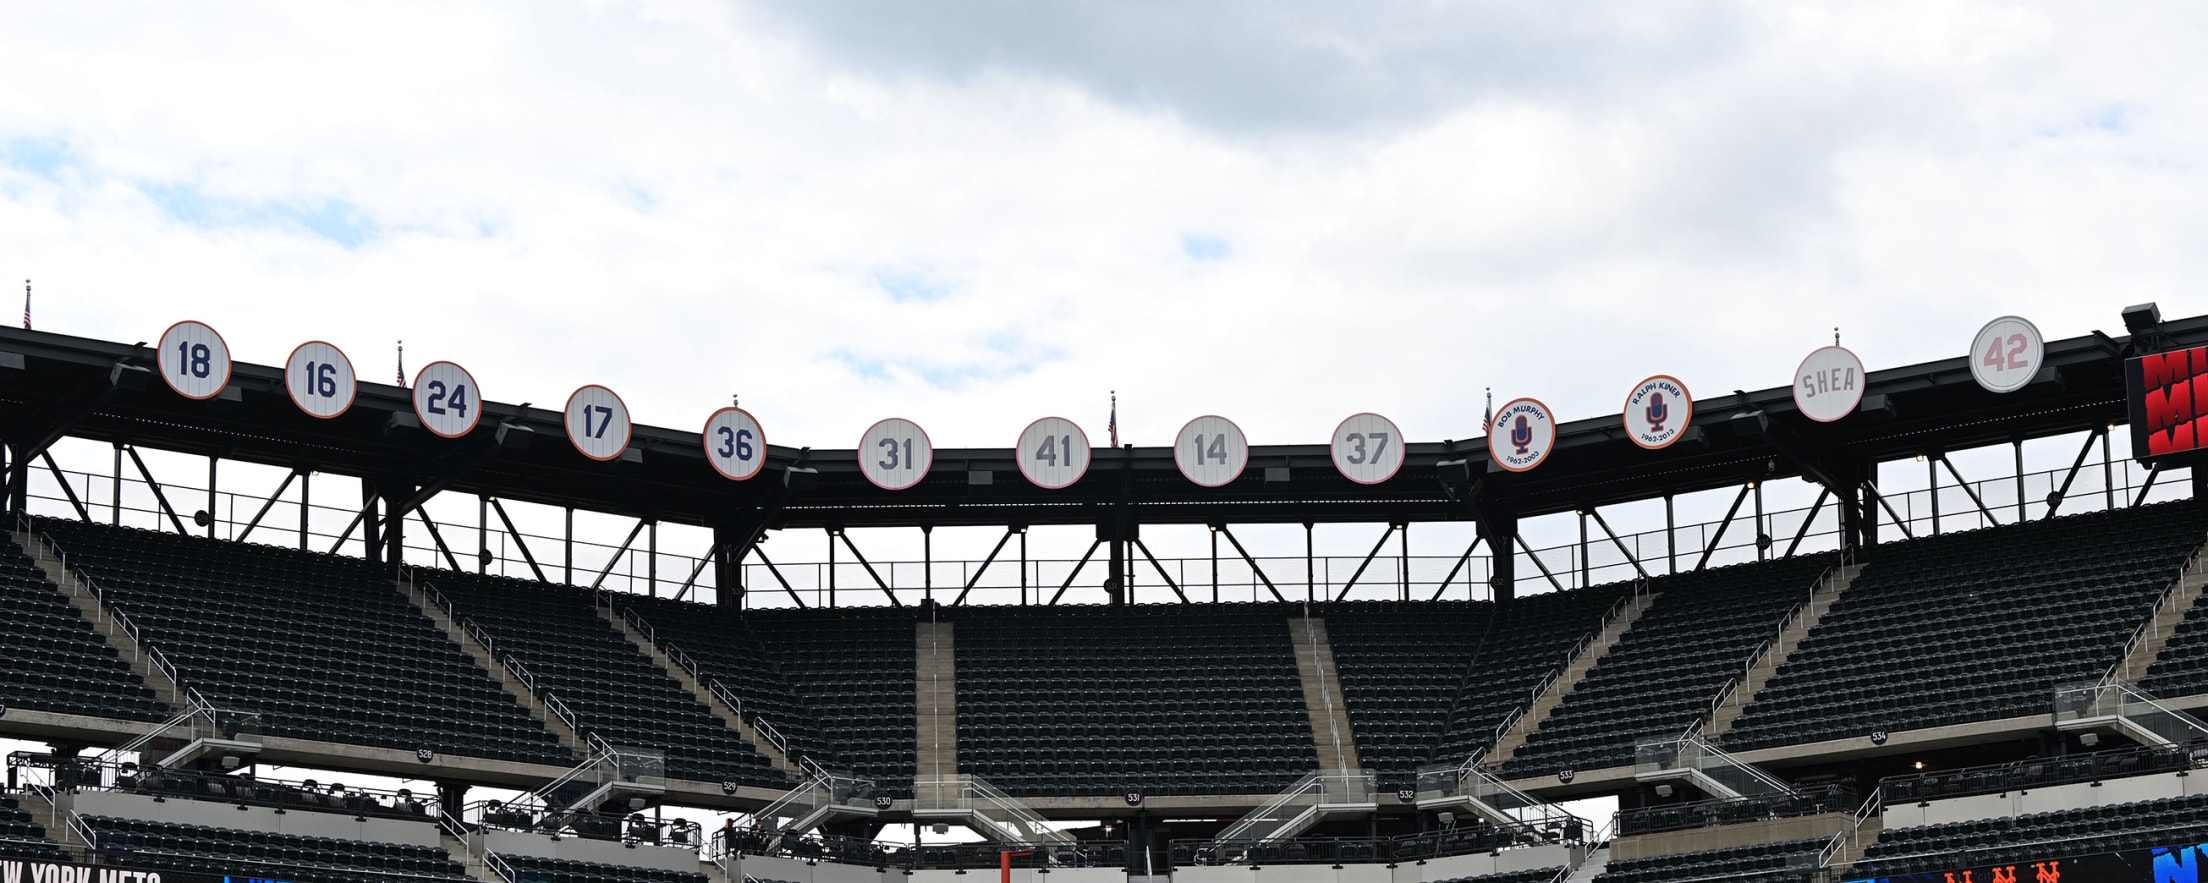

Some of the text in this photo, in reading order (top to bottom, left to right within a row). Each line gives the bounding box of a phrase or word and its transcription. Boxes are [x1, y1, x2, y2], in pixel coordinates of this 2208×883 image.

[179, 341, 211, 379] 18
[1983, 333, 2028, 371] 42
[306, 361, 336, 398] 16
[1803, 367, 1854, 398] SHEA
[427, 380, 467, 418] 24
[1632, 382, 1681, 405] RALPH KINER
[584, 404, 613, 439] 17
[1498, 405, 1545, 428] BOB MURPHY
[717, 426, 753, 462] 36
[1345, 432, 1389, 465] 37
[1641, 428, 1675, 442] 1962-2013
[878, 438, 912, 470] 31
[1036, 435, 1071, 467] 41
[1194, 433, 1227, 466] 14
[1506, 450, 1540, 465] 1962-2003
[1873, 731, 1886, 741] 534
[418, 749, 432, 759] 528
[723, 781, 736, 791] 529
[1560, 770, 1573, 780] 533
[876, 797, 891, 805] 530
[1128, 793, 1140, 802] 531
[1399, 790, 1414, 799] 532
